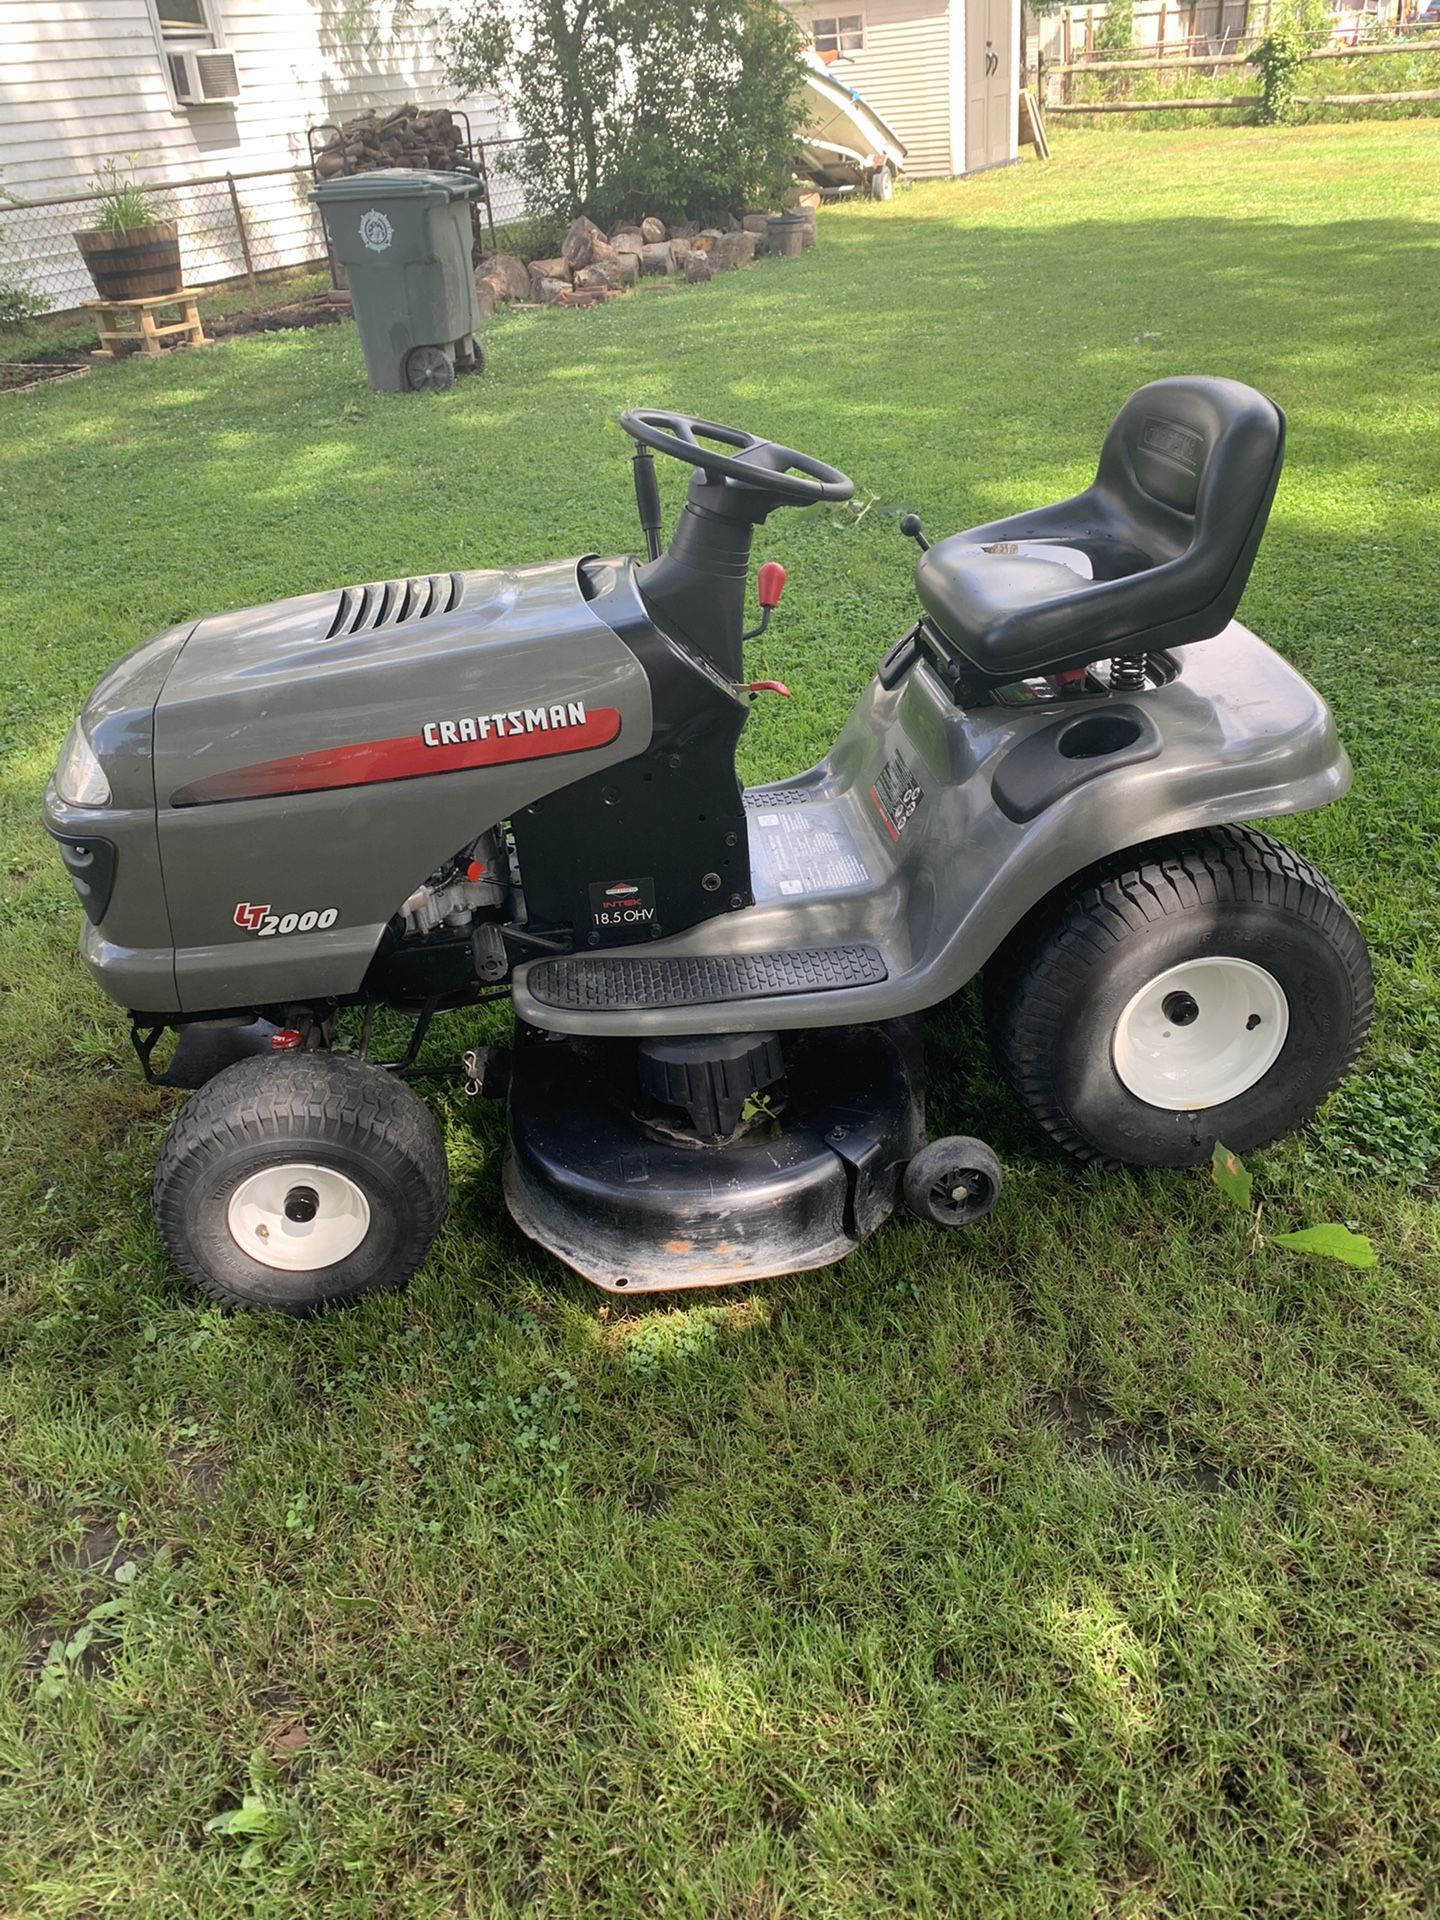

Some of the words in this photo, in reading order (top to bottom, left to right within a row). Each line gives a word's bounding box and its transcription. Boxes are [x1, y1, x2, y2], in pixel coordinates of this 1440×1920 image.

[422, 701, 587, 748] CRAFTSMAN
[602, 898, 642, 909] INTEK
[594, 911, 622, 925] 18.5
[623, 908, 654, 922] OHV
